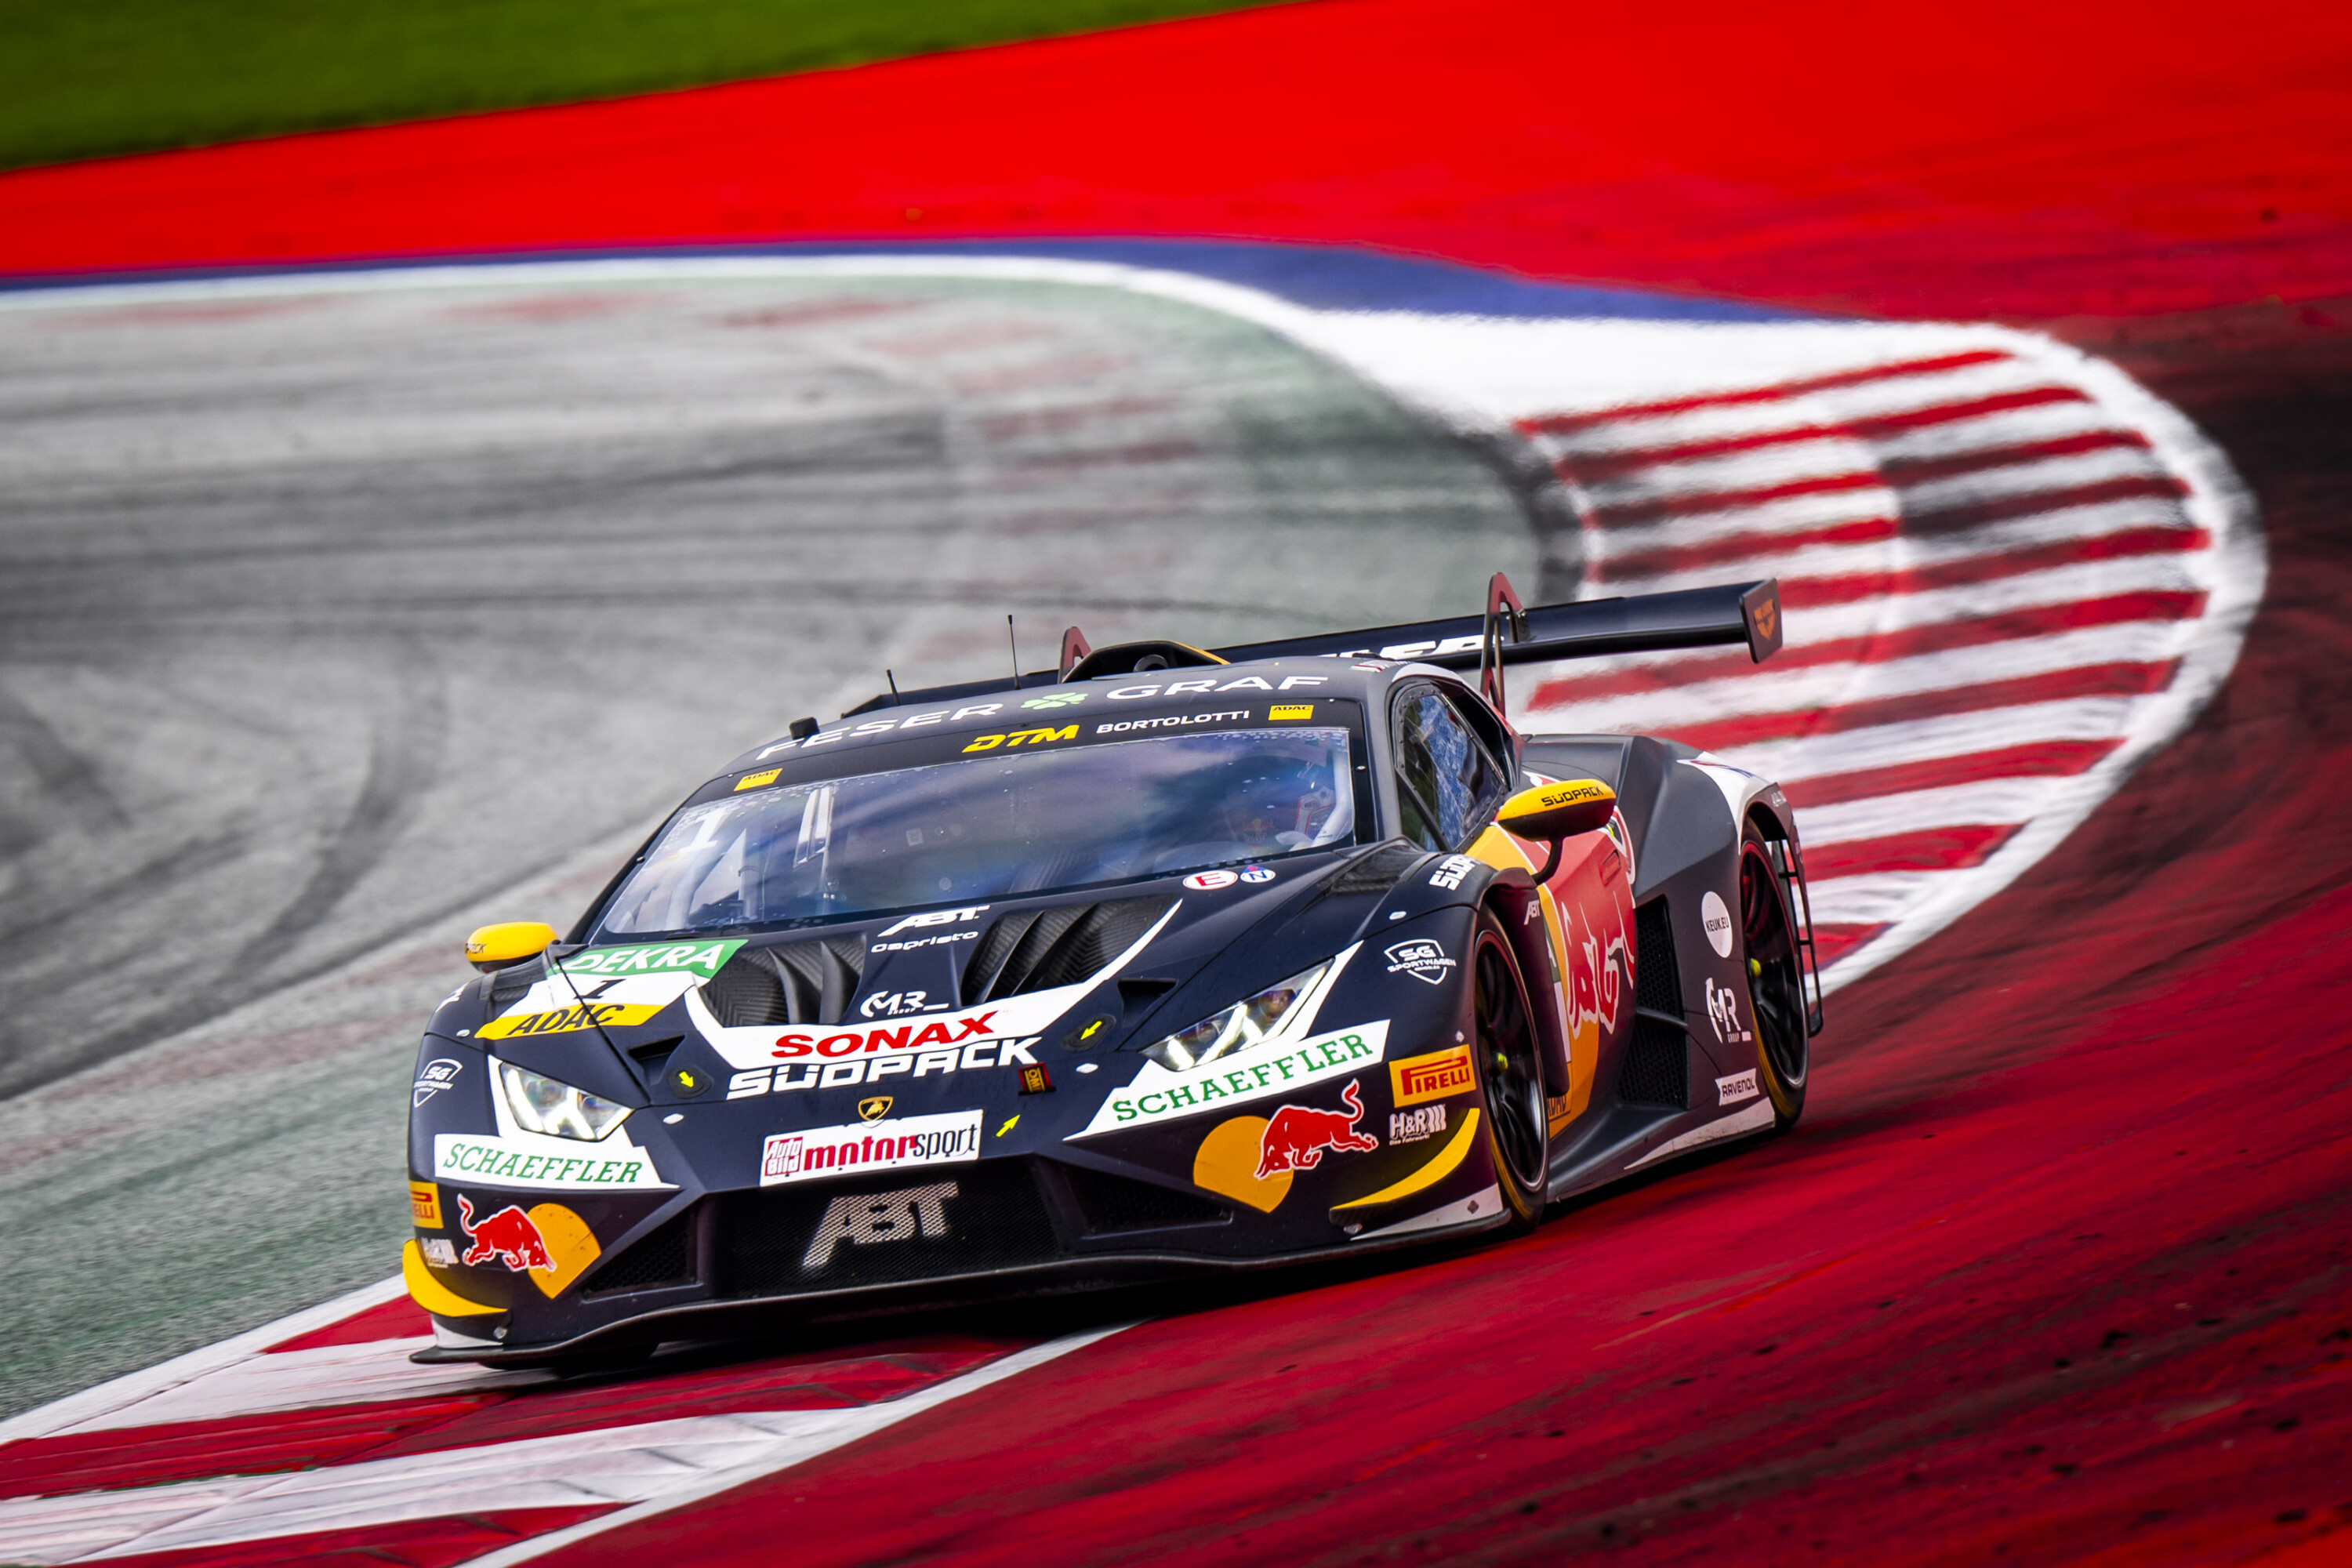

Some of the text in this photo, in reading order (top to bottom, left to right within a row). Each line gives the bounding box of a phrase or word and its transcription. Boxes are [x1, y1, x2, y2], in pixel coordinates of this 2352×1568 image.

[755, 676, 1328, 760] FESER GRAF
[1097, 710, 1250, 734] BORTOLOTTI
[961, 724, 1080, 753] DTM
[1541, 786, 1604, 807] SÜDPACK
[1194, 872, 1227, 887] E
[877, 905, 990, 938] ABT
[1524, 899, 1541, 925] ABT
[554, 943, 724, 972] DEKRA
[1399, 945, 1436, 962] SG
[573, 978, 626, 1000] 1
[506, 1004, 625, 1036] ADAC
[771, 1011, 1000, 1058] SONAX
[423, 1065, 453, 1080] SG
[726, 1036, 1044, 1101] SÜDPACK
[1112, 1033, 1374, 1122] SCHAEFFLER
[1400, 1055, 1471, 1096] PIRELLI
[1722, 1076, 1755, 1097] RAVENOL
[804, 1123, 978, 1171] motorsport
[443, 1142, 643, 1184] SCHAEFFLER
[803, 1181, 960, 1271] ABT
